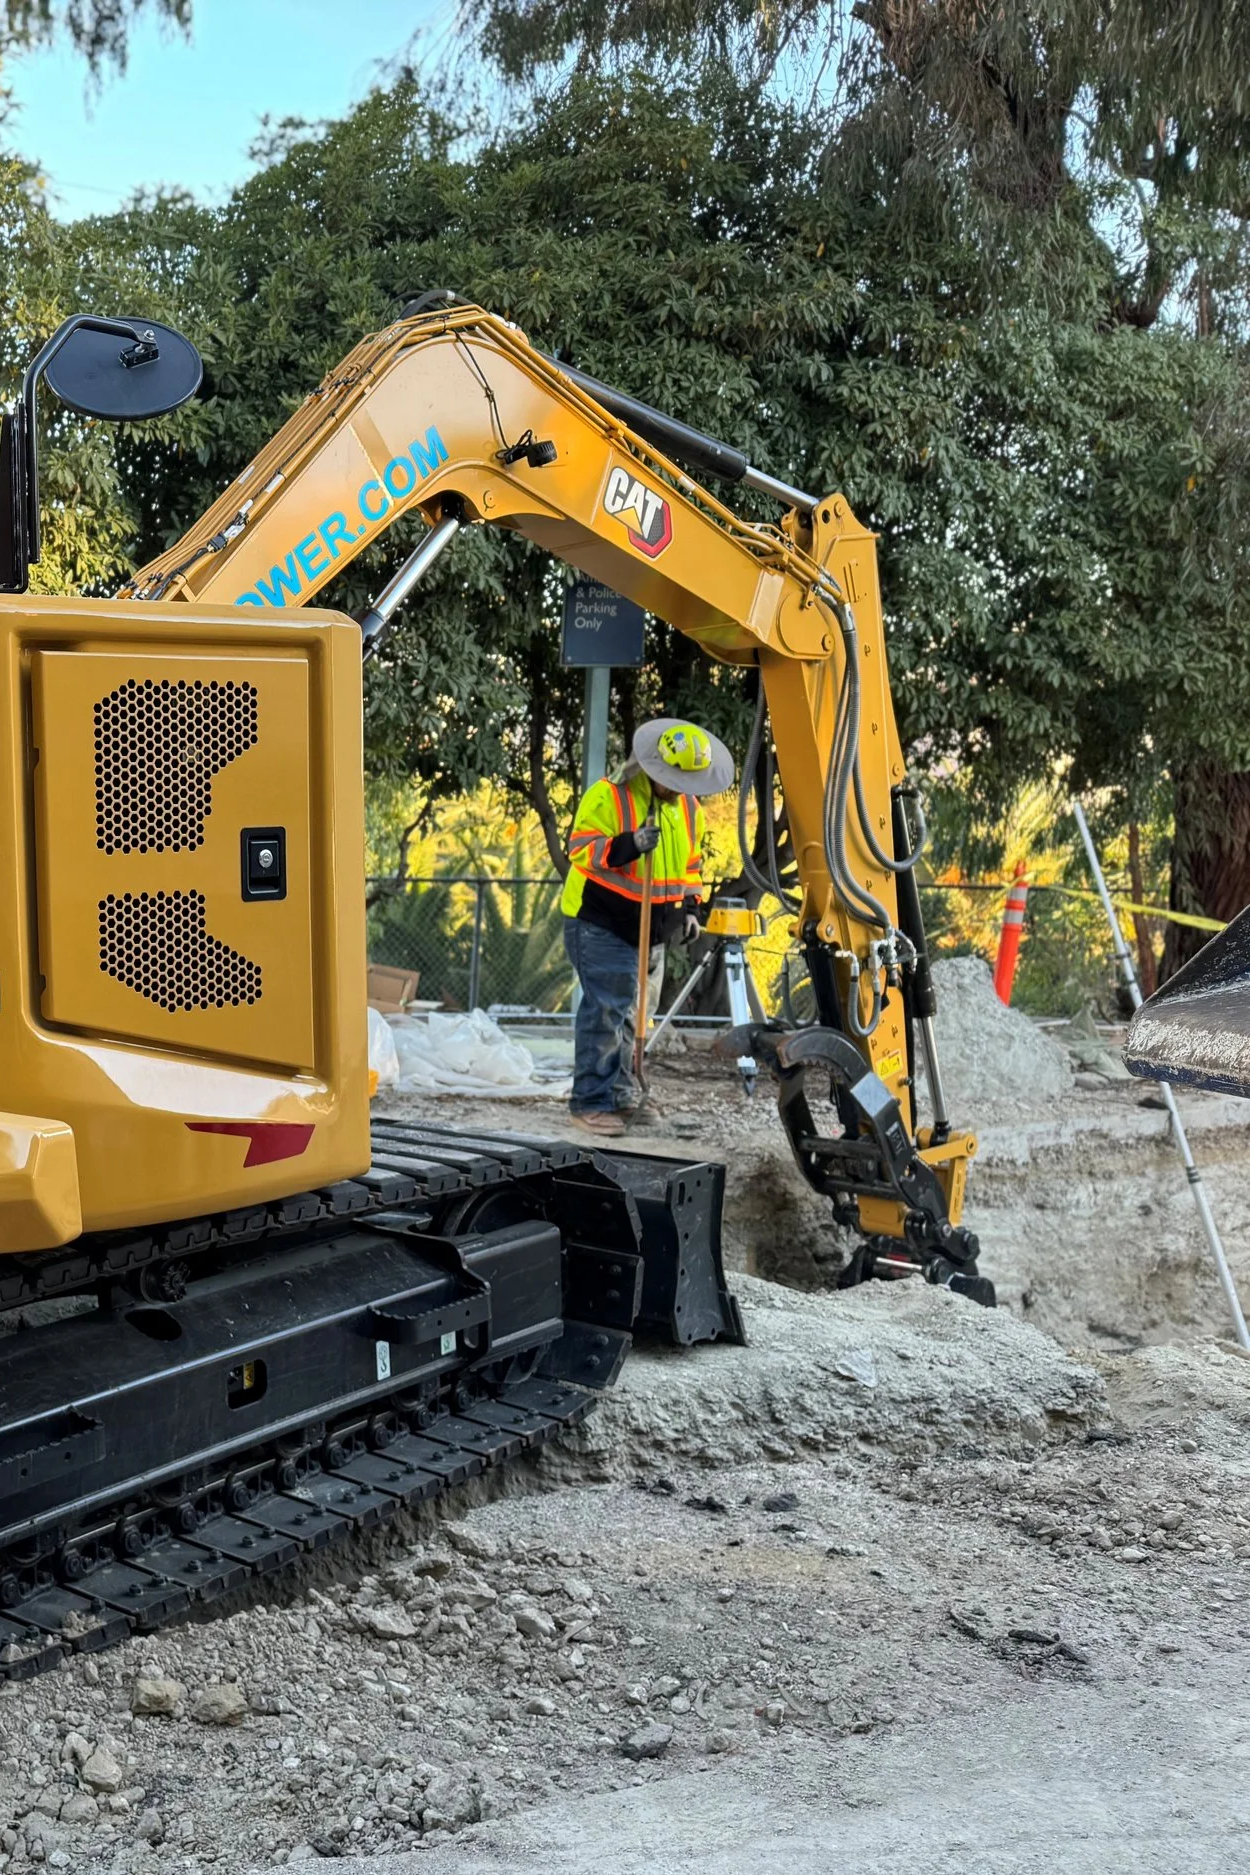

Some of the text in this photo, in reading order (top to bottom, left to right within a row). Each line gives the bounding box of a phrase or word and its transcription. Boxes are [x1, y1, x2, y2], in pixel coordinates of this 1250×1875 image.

[605, 467, 664, 540] CAT
[576, 586, 585, 598] &
[575, 601, 618, 617] Parking
[574, 616, 603, 632] Only
